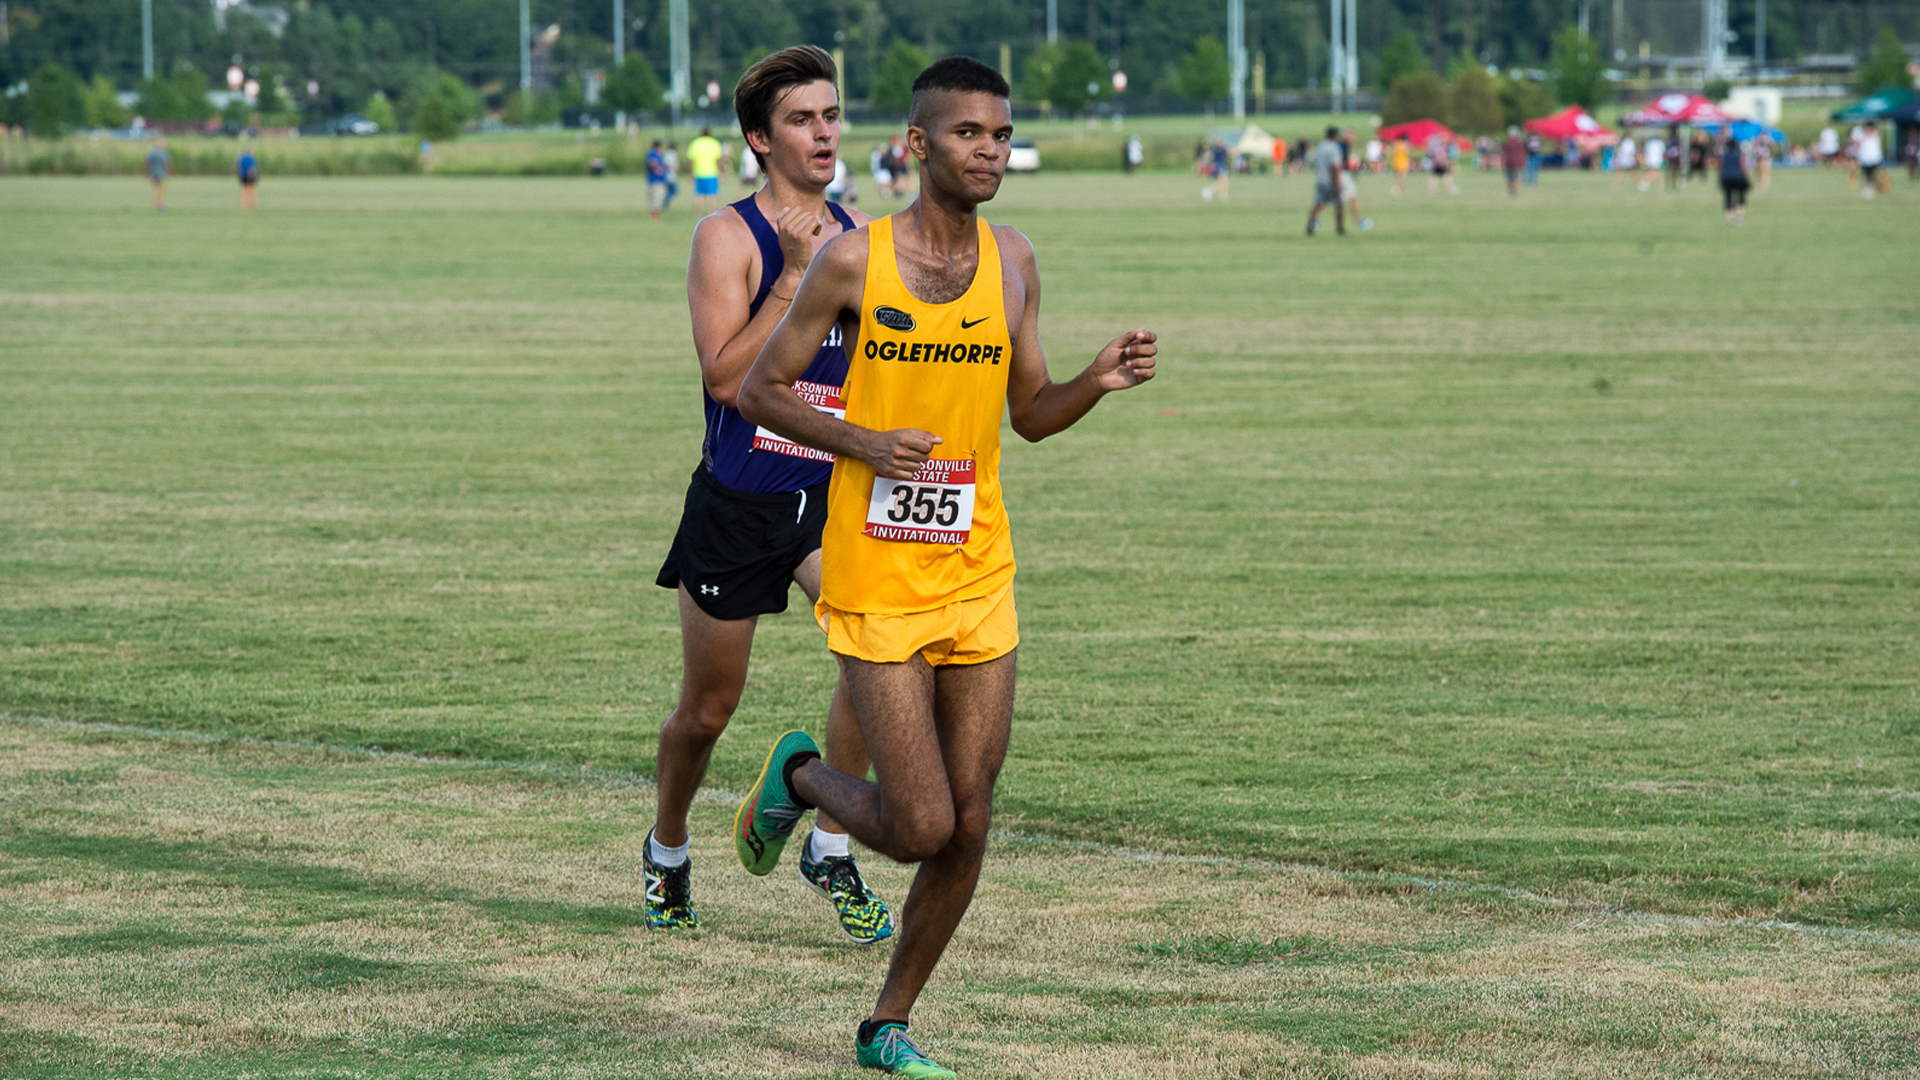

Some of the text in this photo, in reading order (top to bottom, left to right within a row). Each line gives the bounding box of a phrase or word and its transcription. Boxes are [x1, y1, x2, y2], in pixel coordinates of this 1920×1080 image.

[865, 340, 1003, 365] OGLETHORPE
[791, 381, 843, 397] KSONVILL
[760, 439, 834, 462] INVITATIONAL
[920, 459, 972, 472] SONVILLE
[912, 470, 949, 483] STATE
[887, 485, 961, 526] 355
[872, 526, 963, 544] INVITATIONAL
